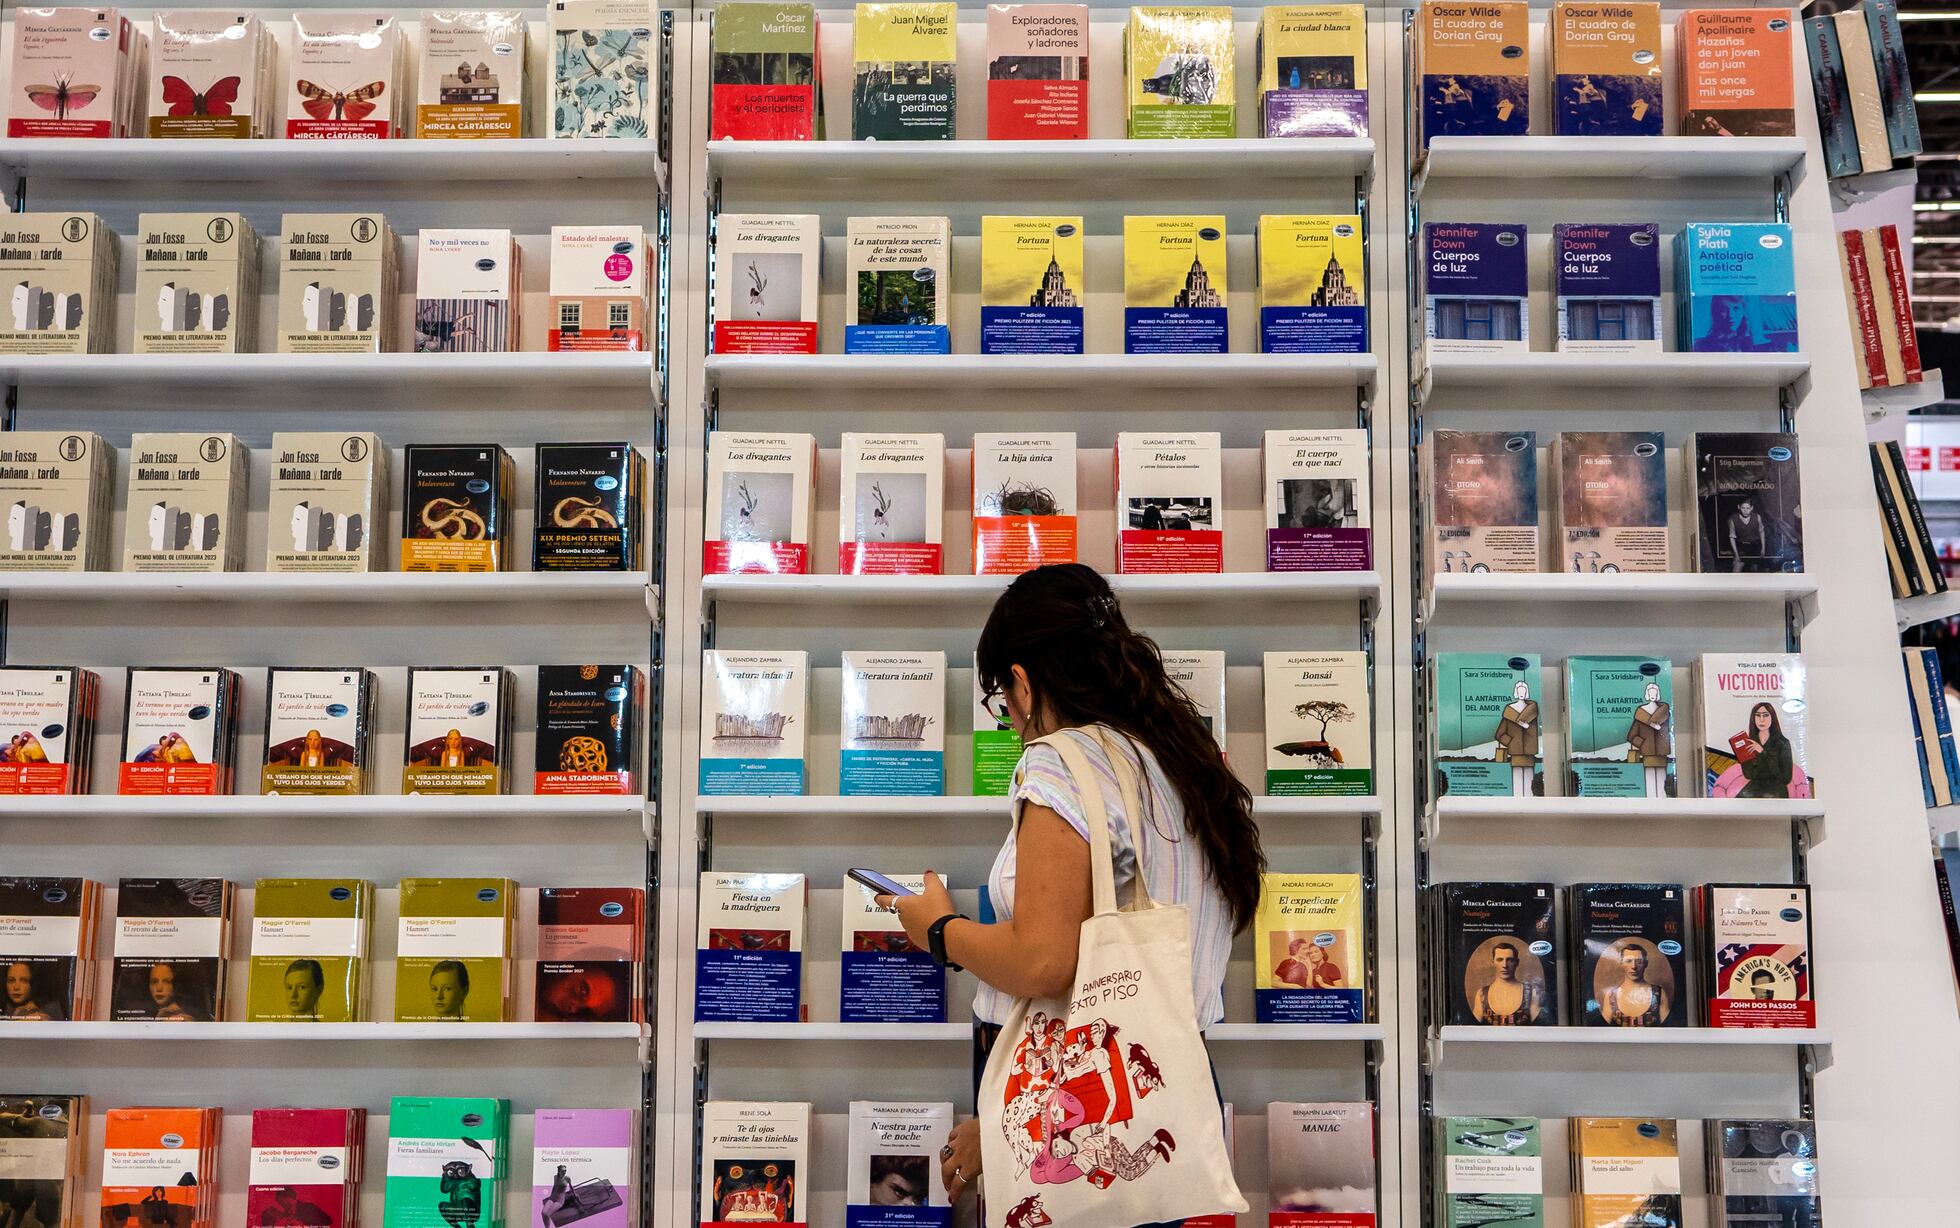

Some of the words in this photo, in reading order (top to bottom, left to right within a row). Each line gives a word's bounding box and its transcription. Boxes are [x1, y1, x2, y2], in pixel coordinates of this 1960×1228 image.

[1433, 6, 1466, 16] Oscar
[1469, 7, 1501, 17] Wilde
[1565, 8, 1598, 17] Oscar
[1601, 8, 1633, 18] Wilde
[776, 11, 806, 23] Óscar
[891, 16, 914, 24] Juan
[915, 15, 948, 28] Miguel
[1012, 15, 1079, 28] Exploradores,
[1697, 14, 1752, 24] Guillaume
[762, 23, 806, 33] Martínez
[1280, 24, 1291, 32] La
[1433, 18, 1443, 28] El
[1447, 19, 1486, 29] cuadro
[1489, 19, 1504, 29] de
[1565, 19, 1576, 29] El
[1579, 19, 1618, 29] cuadro
[1621, 20, 1636, 29] de
[912, 24, 948, 35] Álvarez
[1027, 27, 1078, 36] soñadores
[1697, 25, 1755, 37] Apollinaire
[1433, 30, 1471, 40] Dorian
[1474, 30, 1502, 43] Gray
[1565, 30, 1604, 41] Dorian
[1607, 31, 1635, 43] Gray
[1698, 36, 1745, 46] Hazañas
[1036, 38, 1078, 48] ladrones
[1697, 48, 1712, 58] de
[1731, 48, 1760, 59] joven
[1698, 60, 1719, 69] don
[1721, 58, 1745, 71] juan
[1699, 76, 1718, 85] Las
[1720, 77, 1746, 85] once
[1699, 87, 1716, 96] mil
[1719, 88, 1755, 98] vergas
[883, 92, 895, 101] La
[896, 94, 927, 105] guerra
[928, 94, 948, 103] que
[901, 102, 948, 114] perdimos
[423, 123, 456, 131] MIRCEA
[737, 233, 753, 241] Los
[755, 233, 800, 242] divagantes
[1433, 227, 1478, 238] Jennifer
[1698, 227, 1731, 239] Sylvia
[146, 232, 161, 244] Jon
[162, 232, 185, 244] Fosse
[599, 235, 630, 243] malestar
[866, 237, 909, 247] naturaleza
[1017, 236, 1050, 244] Fortuna
[1433, 238, 1465, 249] Down
[1698, 238, 1728, 249] Plath
[145, 249, 177, 261] Mañana
[186, 248, 208, 261] tarde
[873, 246, 883, 254] de
[885, 246, 897, 254] las
[867, 255, 878, 263] de
[1433, 250, 1480, 264] Cuerpos
[1699, 251, 1754, 264] Antología
[1433, 262, 1447, 272] de
[1450, 262, 1467, 272] luz
[1700, 261, 1743, 274] poética
[139, 452, 153, 464] Jon
[155, 451, 178, 464] Fosse
[998, 454, 1009, 462] La
[1011, 453, 1027, 463] hija
[1029, 454, 1053, 462] única
[1155, 453, 1186, 461] Pétalos
[1307, 451, 1338, 459] cuerpo
[1324, 458, 1342, 466] nací
[137, 468, 169, 480] Mañana
[178, 468, 200, 480] tarde
[901, 672, 933, 680] infantil
[1302, 671, 1332, 679] Bonsái
[1480, 671, 1513, 679] Stridsberg
[1475, 694, 1512, 702] ANTÁRTIDA
[732, 893, 758, 902] Fiesta
[1279, 896, 1289, 905] El
[1290, 896, 1338, 906] expediente
[731, 903, 780, 912] madriguera
[1281, 906, 1292, 914] de
[1294, 905, 1306, 914] mi
[1308, 906, 1336, 914] madre
[1735, 958, 1771, 983] AMERICA'S
[1774, 962, 1792, 983] HOPE
[1071, 995, 1097, 1014] EXTO
[1103, 984, 1138, 1003] PISO
[758, 1125, 775, 1134] ojos
[871, 1122, 906, 1133] Nuestra
[908, 1124, 932, 1133] parte
[1302, 1124, 1340, 1132] MANIAC
[719, 1134, 750, 1142] miraste
[751, 1133, 763, 1142] las
[764, 1134, 798, 1143] tinieblas
[881, 1132, 892, 1140] de
[894, 1131, 921, 1141] noche
